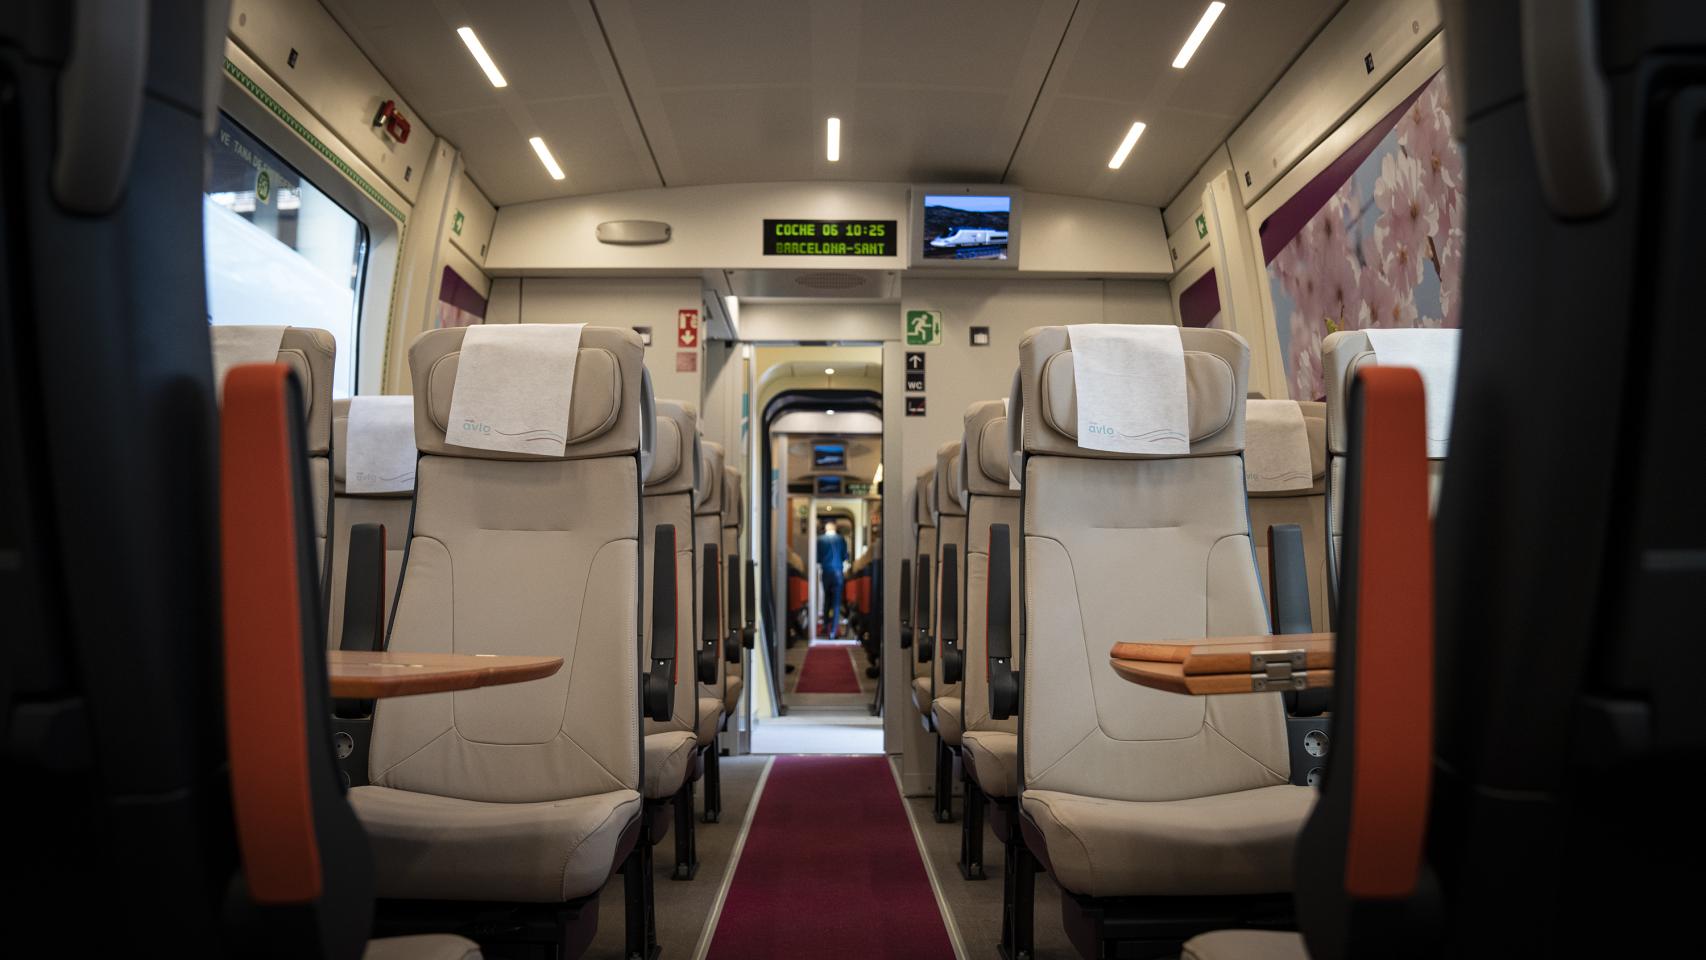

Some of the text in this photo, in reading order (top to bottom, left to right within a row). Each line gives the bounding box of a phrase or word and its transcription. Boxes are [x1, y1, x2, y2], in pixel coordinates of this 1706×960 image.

[776, 224, 885, 236] COCHE 06 10:25
[908, 381, 922, 390] WC
[1088, 423, 1114, 435] avlo
